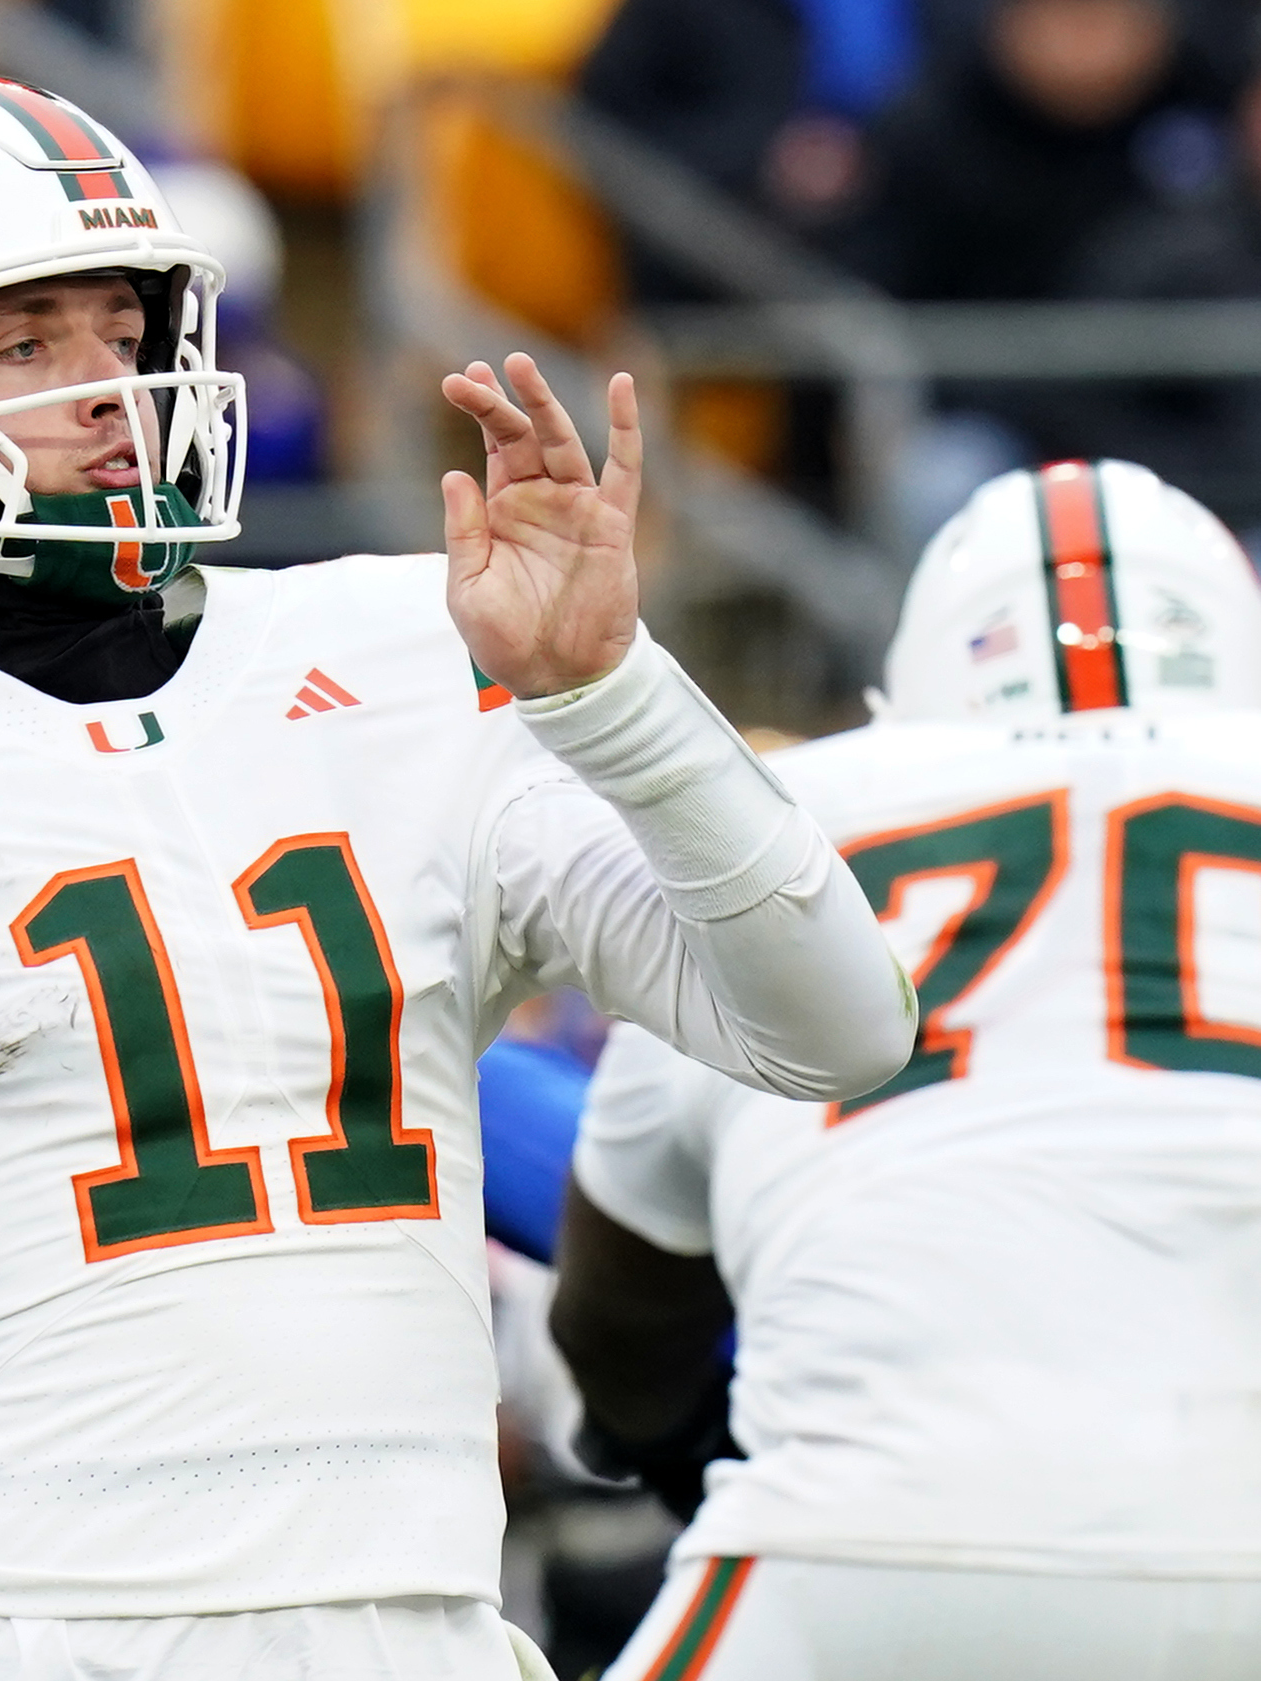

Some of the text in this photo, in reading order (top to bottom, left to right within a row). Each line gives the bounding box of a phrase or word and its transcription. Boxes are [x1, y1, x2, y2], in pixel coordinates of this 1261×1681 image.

[77, 206, 158, 230] MIAMI
[105, 494, 179, 593] U
[85, 711, 165, 753] U
[9, 831, 441, 1264] 11
